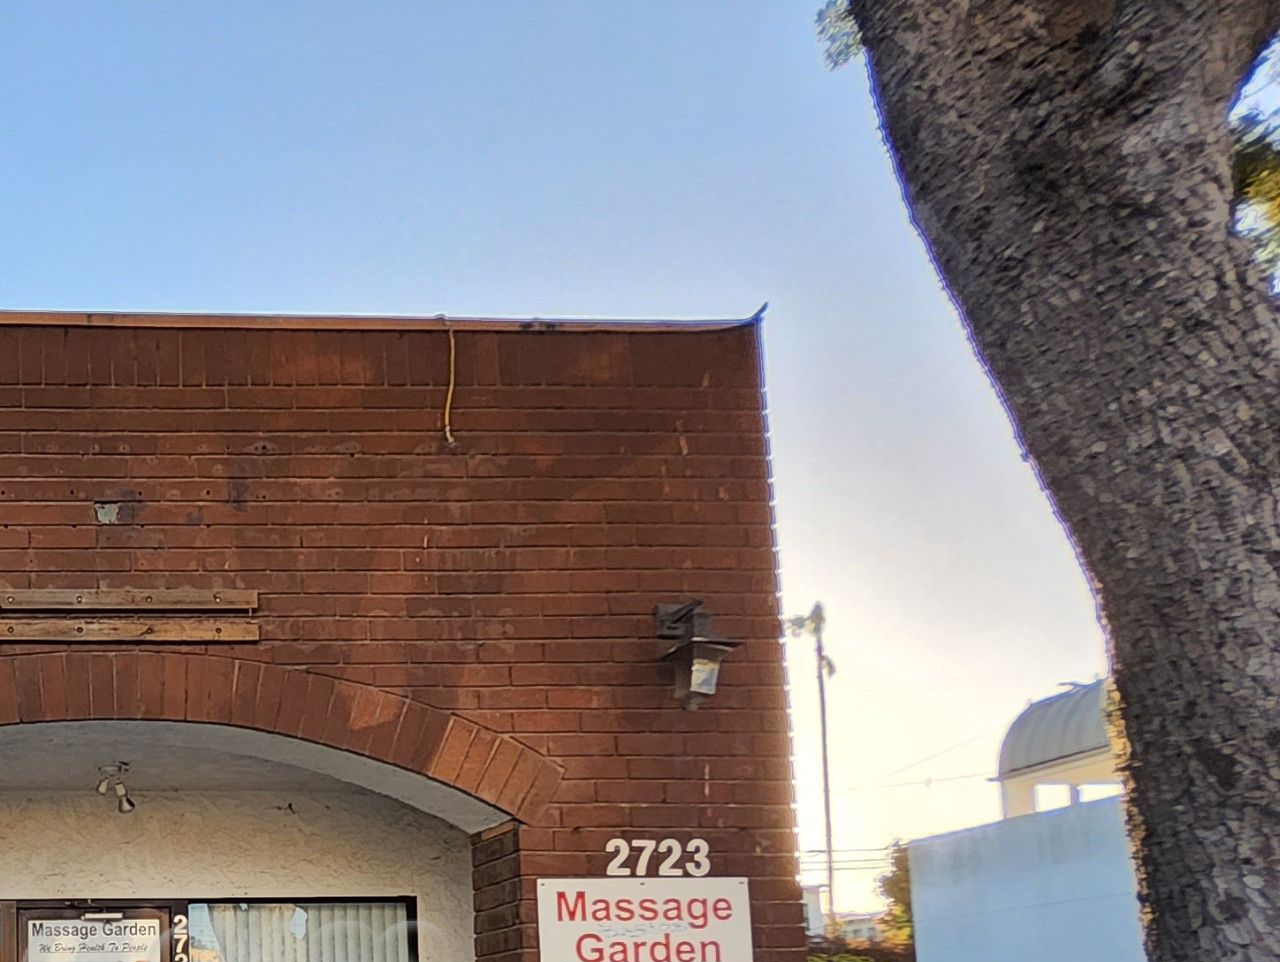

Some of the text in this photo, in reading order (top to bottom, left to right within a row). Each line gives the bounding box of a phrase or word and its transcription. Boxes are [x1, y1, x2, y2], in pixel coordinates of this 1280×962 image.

[605, 838, 711, 877] 2723
[556, 891, 733, 929] Massage
[31, 922, 156, 940] Massage Garden
[54, 943, 76, 954] Bring
[78, 942, 106, 952] Health
[108, 942, 119, 952] To
[121, 943, 148, 953] People
